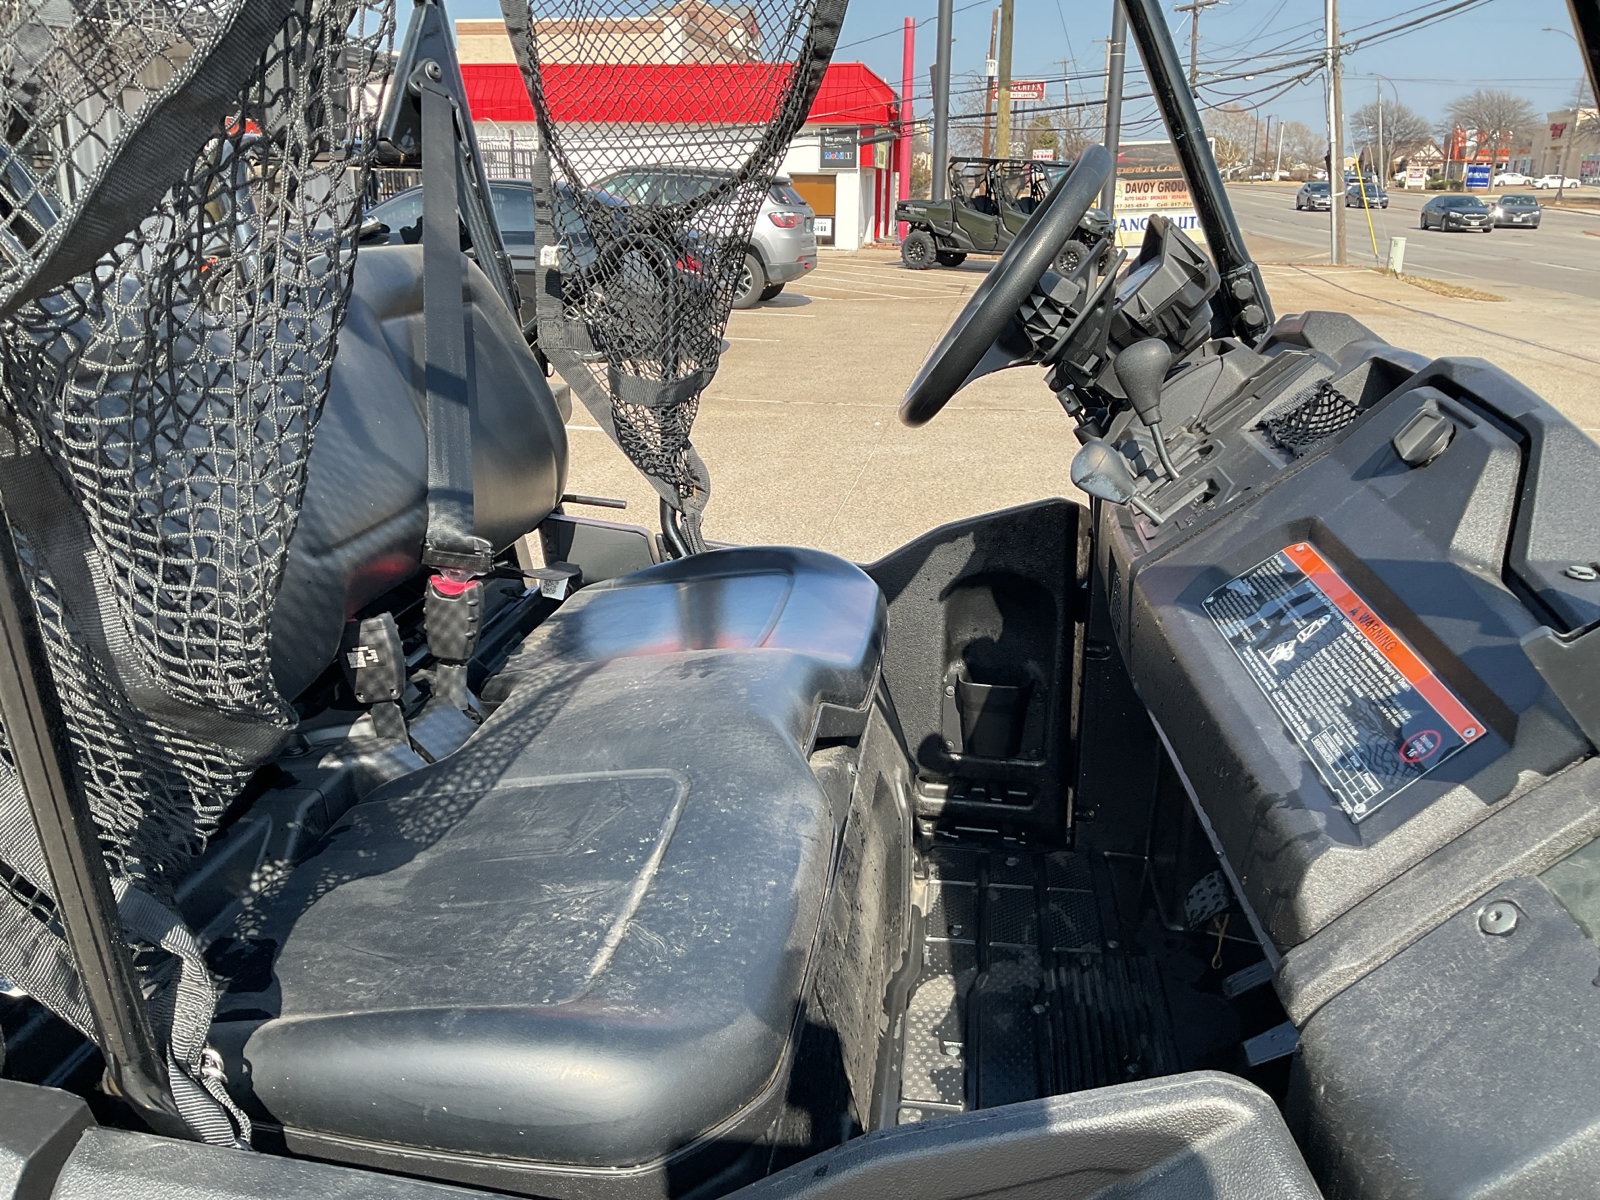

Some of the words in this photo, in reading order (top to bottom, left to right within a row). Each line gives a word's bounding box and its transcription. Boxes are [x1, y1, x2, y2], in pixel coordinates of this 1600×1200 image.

[825, 151, 844, 159] Mobil
[1125, 182, 1156, 194] DAVOY
[1355, 611, 1398, 652] WARNING
[1411, 739, 1427, 754] UNDER
[1418, 733, 1435, 749] DRIVER
[1405, 747, 1417, 758] 16
